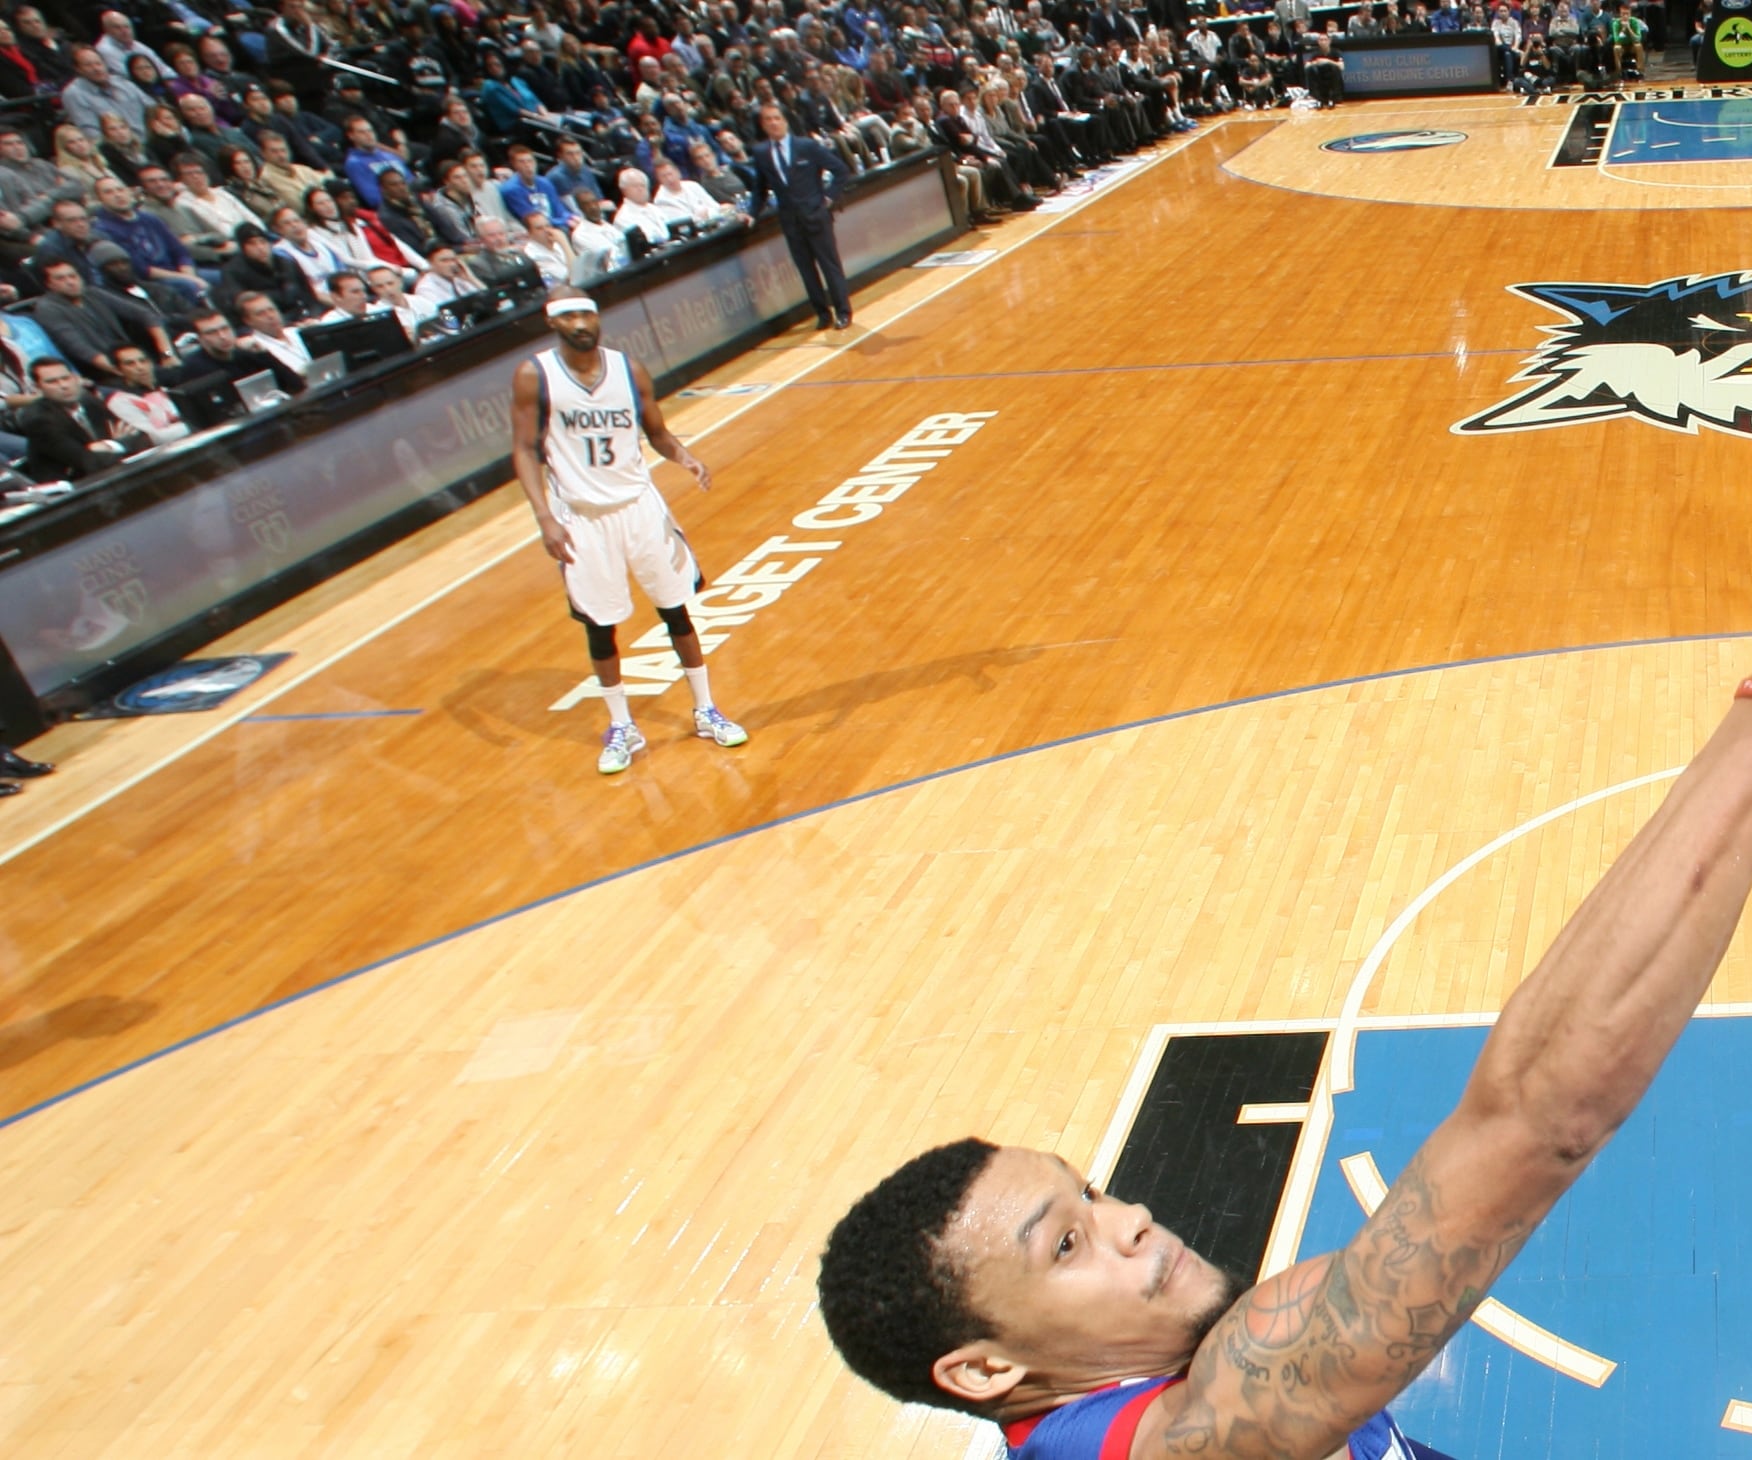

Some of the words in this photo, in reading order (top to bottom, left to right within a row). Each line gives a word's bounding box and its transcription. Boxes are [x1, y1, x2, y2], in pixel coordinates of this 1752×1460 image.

[1362, 55, 1392, 67] MAYO
[1395, 54, 1432, 67] CLINIC
[1343, 71, 1369, 83] ORTS
[1373, 67, 1425, 81] MEDICINE
[1428, 65, 1470, 79] CENTER
[671, 276, 757, 339] Medicine
[560, 408, 633, 430] WOLVES
[583, 437, 616, 467] 13
[791, 410, 999, 530] CENTER
